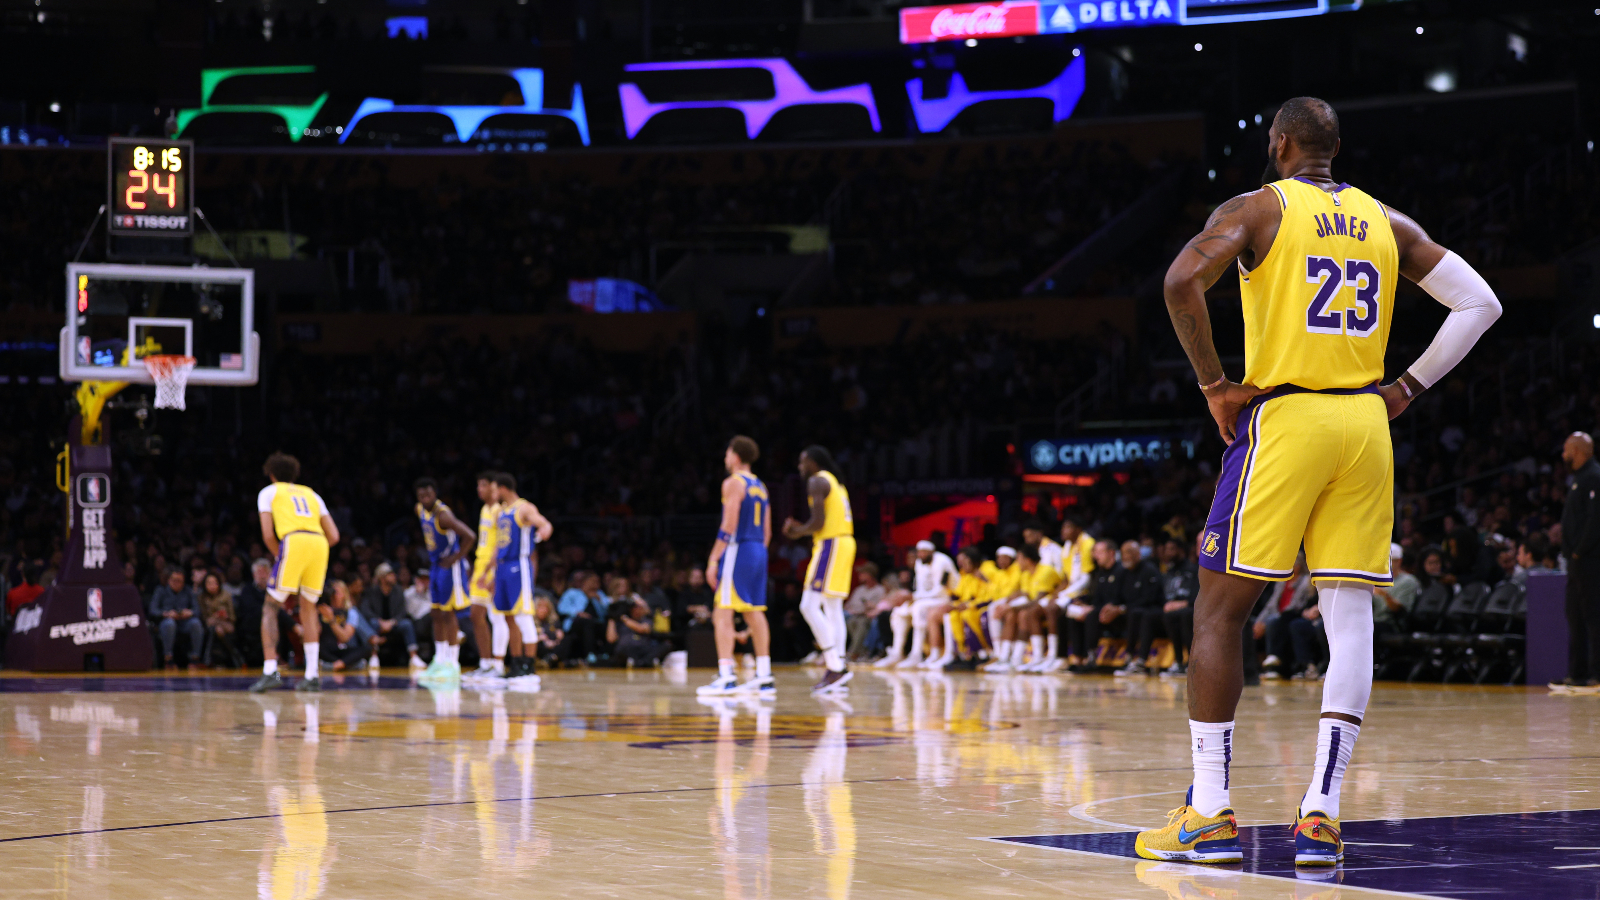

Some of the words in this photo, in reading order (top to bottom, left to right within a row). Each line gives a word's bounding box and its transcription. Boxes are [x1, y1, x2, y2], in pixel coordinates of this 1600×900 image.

[1079, 0, 1172, 23] DELTA
[134, 146, 182, 172] 8:15
[126, 170, 176, 209] 24
[135, 215, 188, 229] TISSOT
[1314, 213, 1368, 241] JAMES
[1306, 255, 1381, 338] 23
[1059, 438, 1194, 468] crypto.c
[291, 495, 312, 517] 11
[82, 509, 105, 528] GET
[82, 528, 106, 548] THE
[83, 549, 107, 569] APP
[49, 614, 139, 639] EVERYONE'S
[73, 629, 116, 645] GAME
